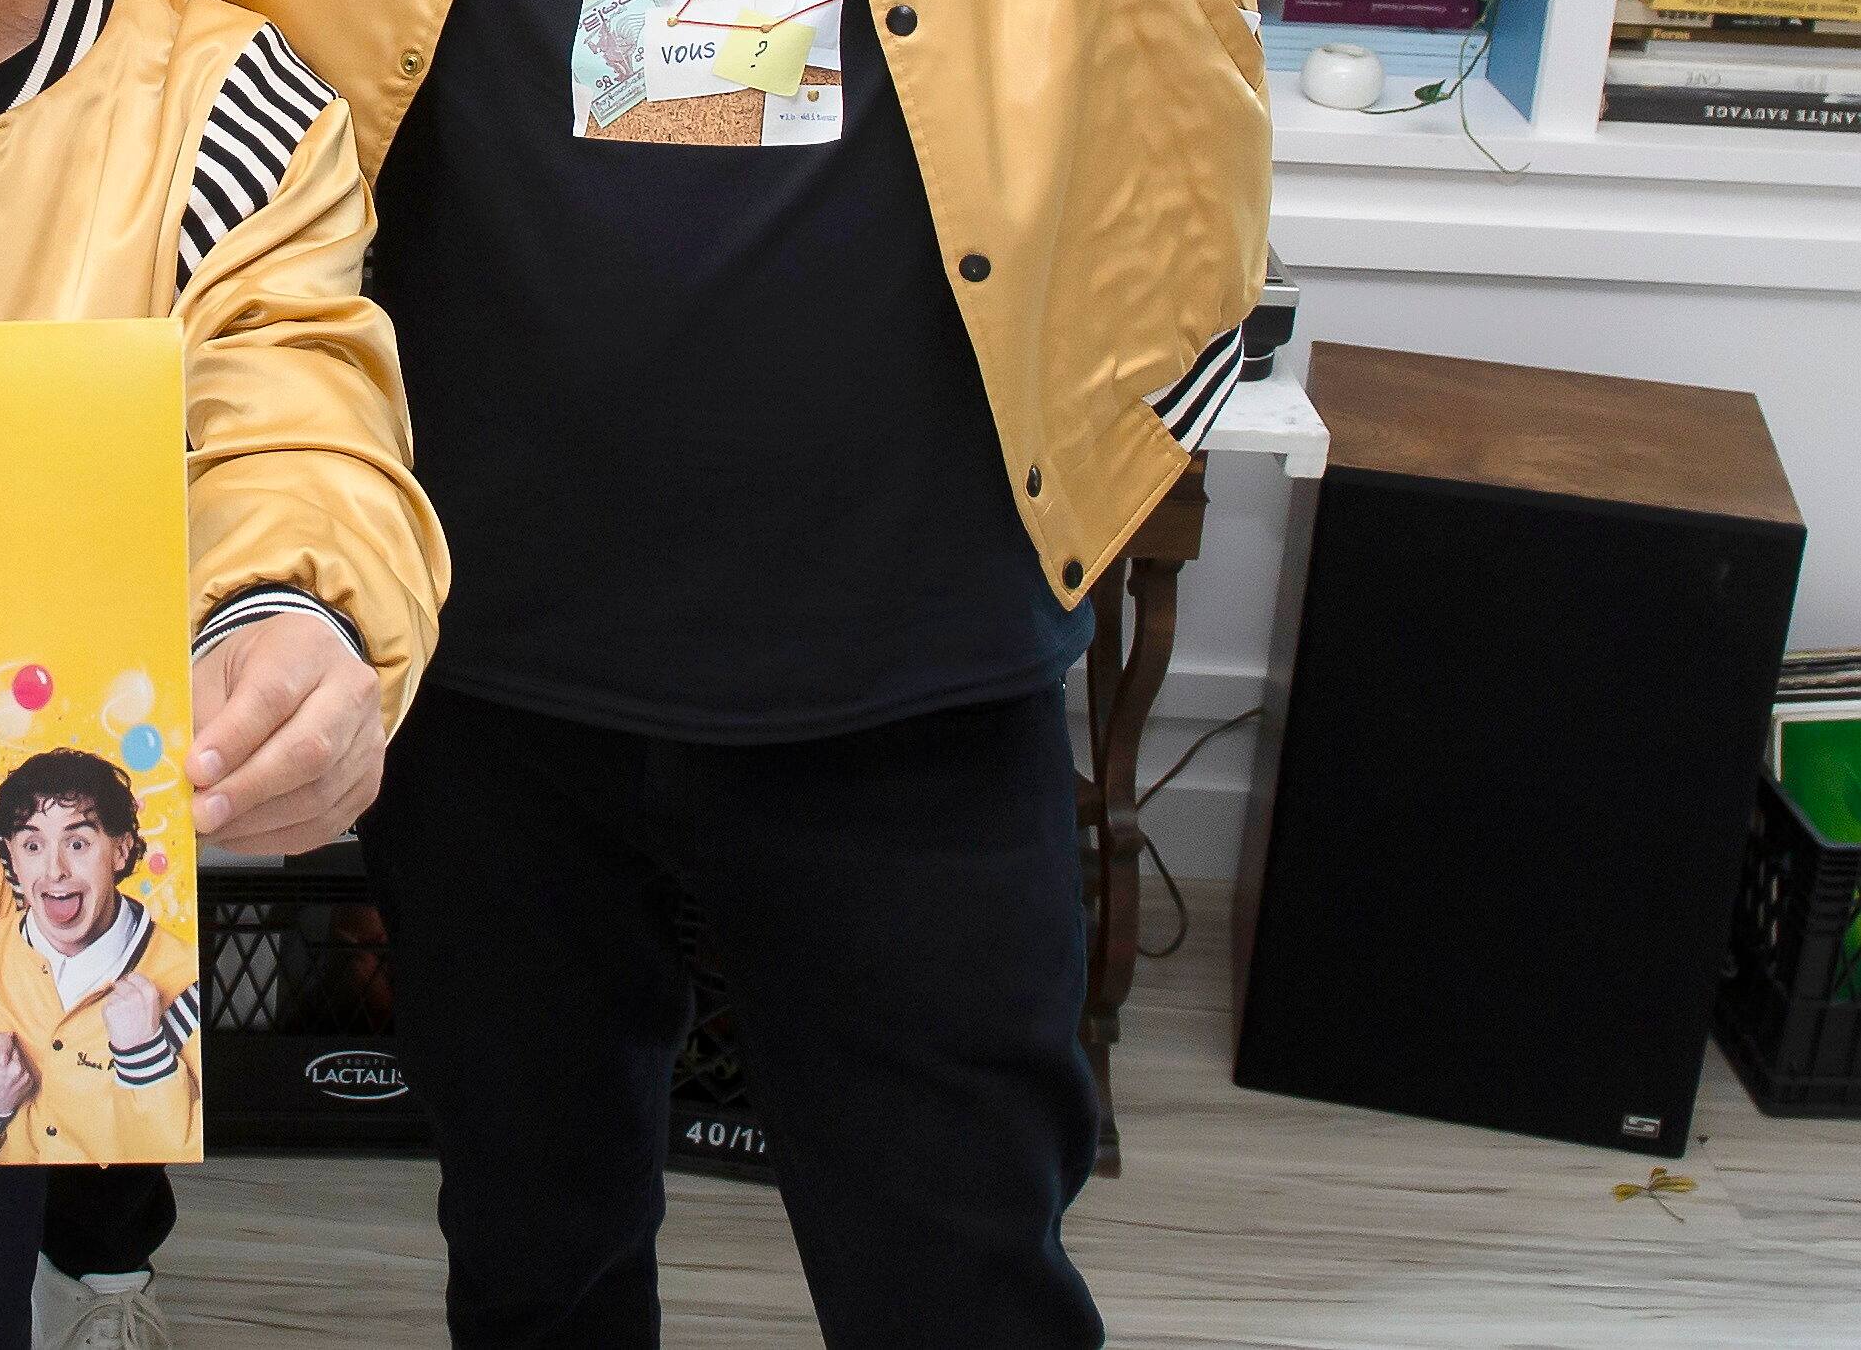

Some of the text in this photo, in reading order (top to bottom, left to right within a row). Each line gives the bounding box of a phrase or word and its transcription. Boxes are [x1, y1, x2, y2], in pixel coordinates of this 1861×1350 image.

[660, 41, 716, 65] vous
[1703, 104, 1861, 126] ANÈTE SAUVAGE
